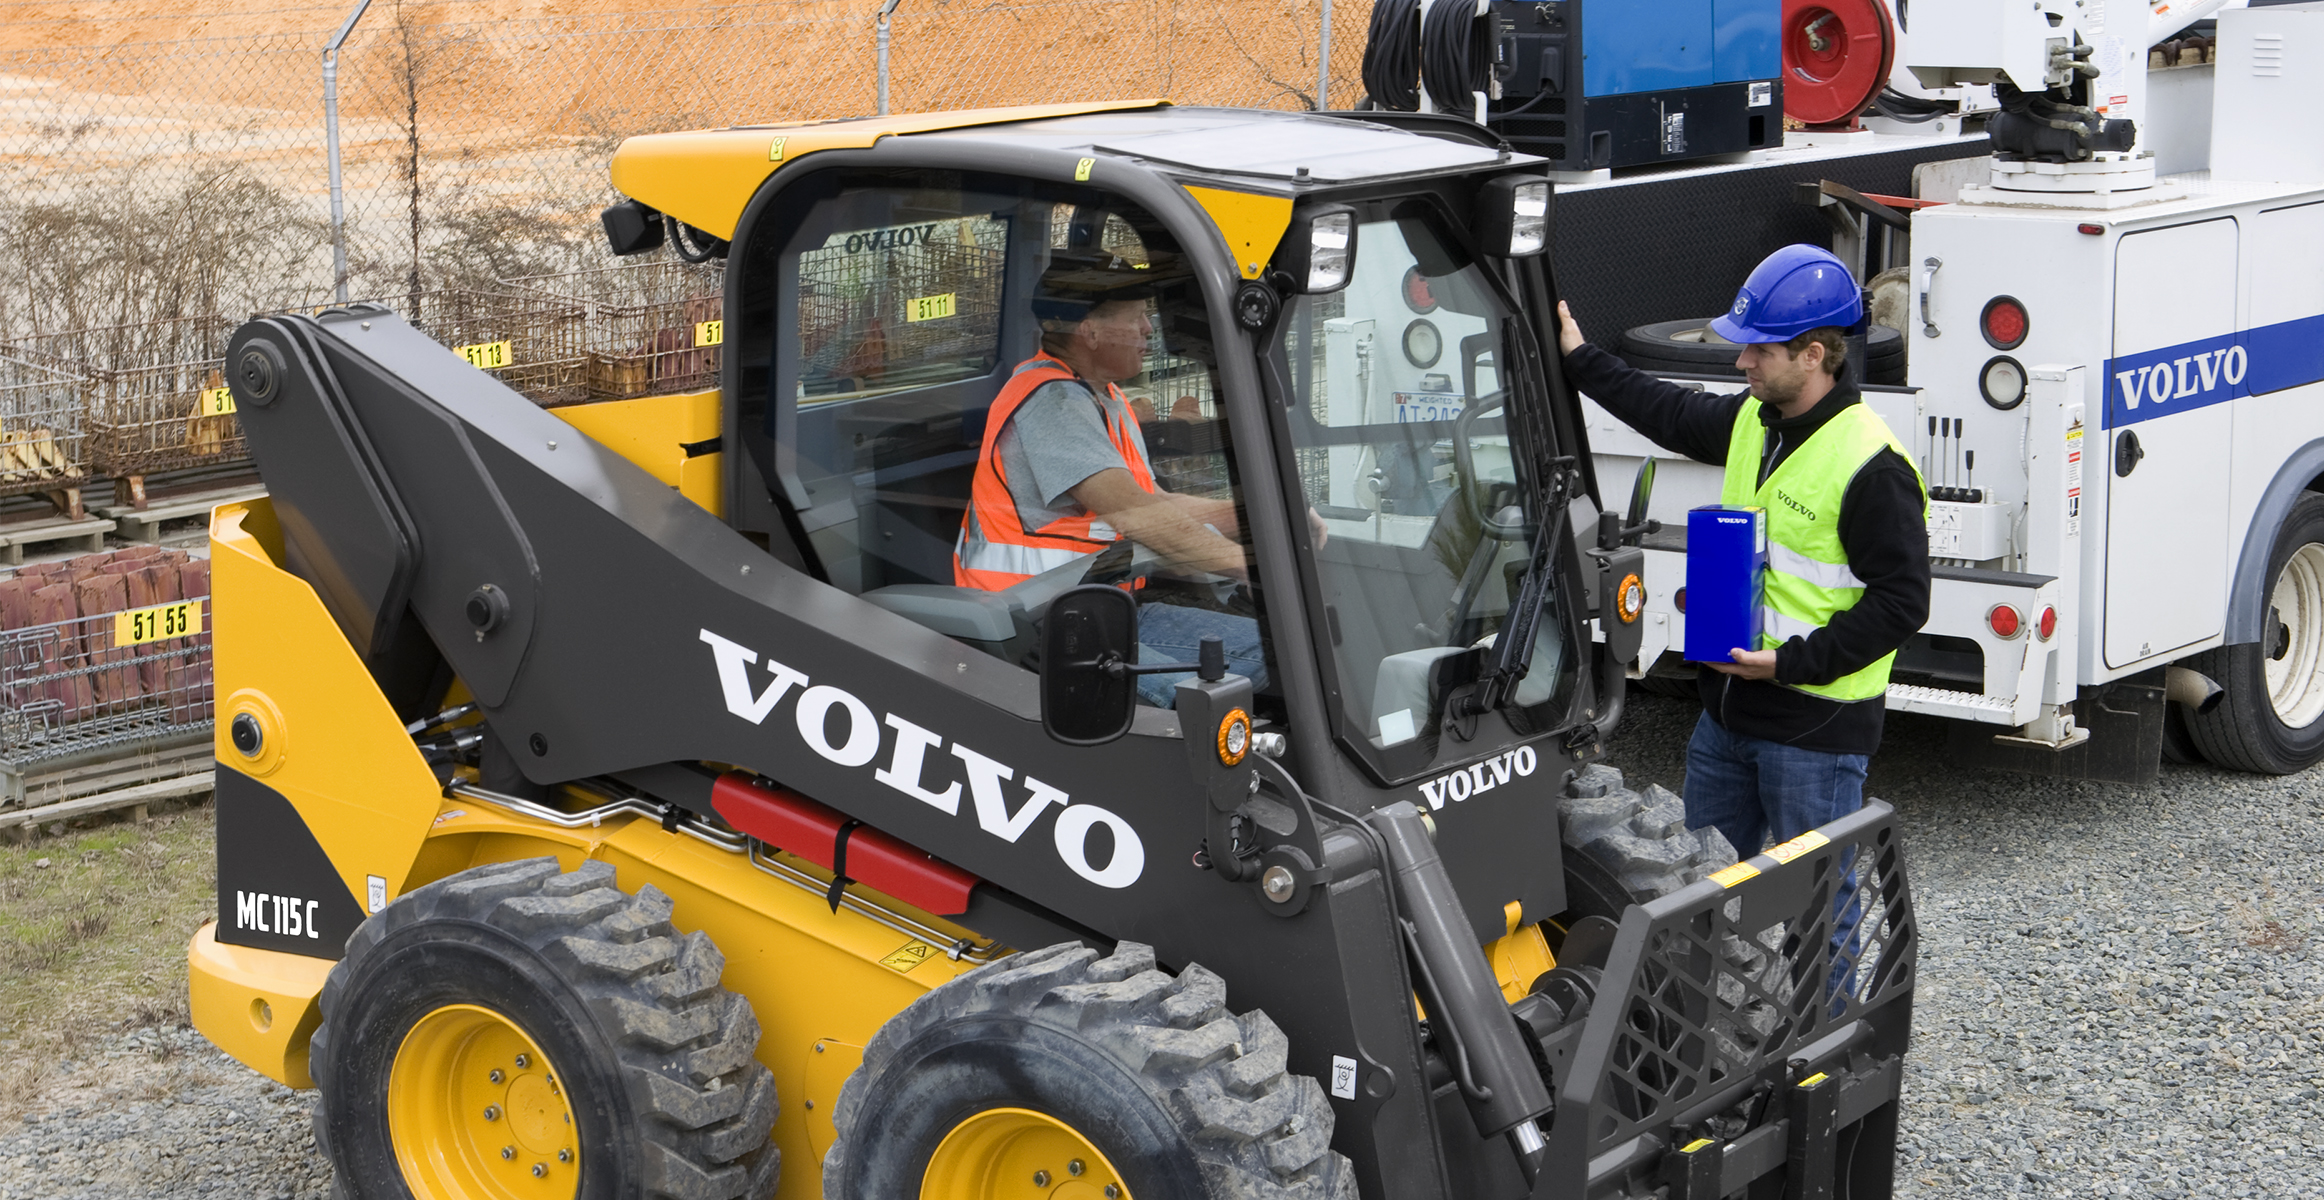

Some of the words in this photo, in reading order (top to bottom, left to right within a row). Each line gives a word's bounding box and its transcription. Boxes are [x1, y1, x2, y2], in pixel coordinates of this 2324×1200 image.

[919, 300, 932, 319] 51
[936, 296, 948, 316] 11
[707, 323, 720, 343] 51
[467, 346, 482, 367] 51
[488, 344, 502, 365] 13
[2115, 345, 2248, 410] VOLVO
[216, 390, 231, 412] 51
[1418, 396, 1453, 405] WEIGHTED
[1777, 489, 1817, 522] VOLVO
[1717, 517, 1748, 525] VOLVO
[134, 611, 155, 641] 51
[166, 604, 187, 635] 55
[700, 628, 1145, 889] VOLVO
[1418, 745, 1537, 811] VOLVO
